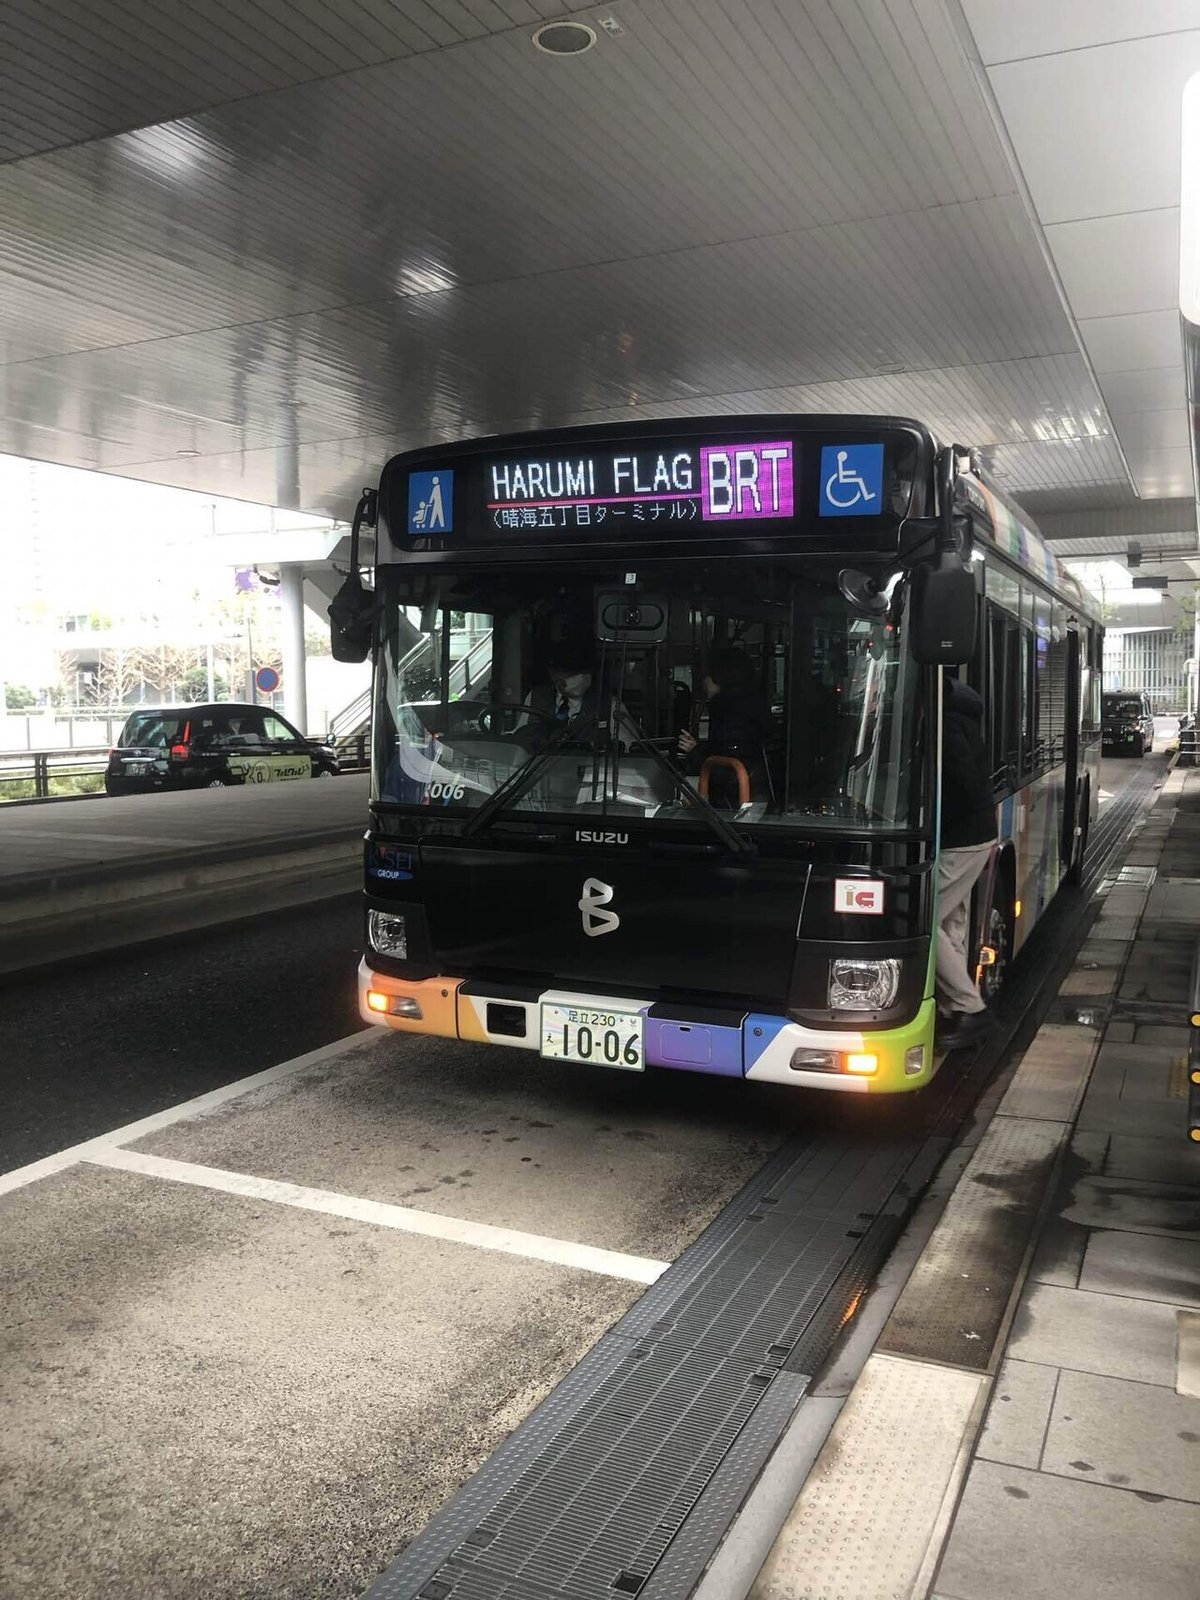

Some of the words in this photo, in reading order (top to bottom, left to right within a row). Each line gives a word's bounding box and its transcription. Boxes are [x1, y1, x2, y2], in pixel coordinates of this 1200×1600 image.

[492, 461, 595, 499] HARUMI
[613, 453, 693, 492] FLAG
[709, 448, 788, 515] BRT
[575, 830, 629, 844] ISUZU
[377, 869, 400, 879] GROUP
[564, 1024, 639, 1065] 10-06
